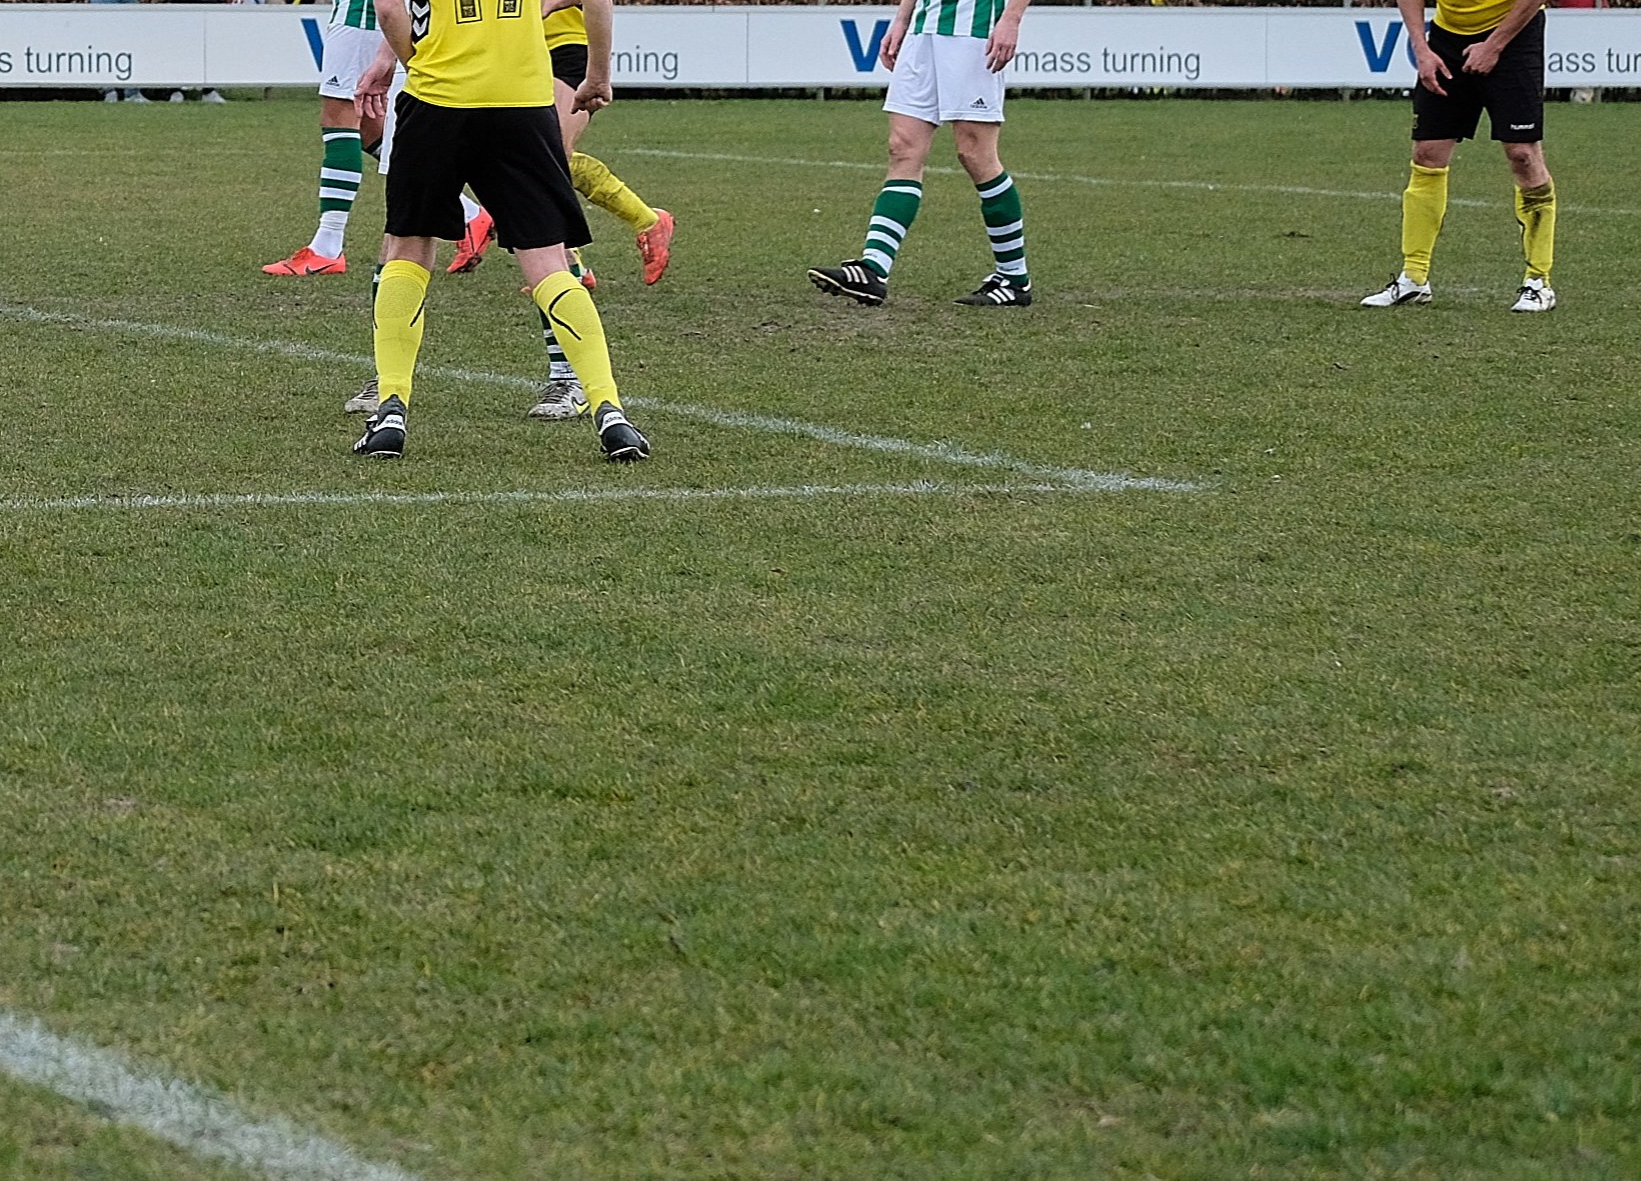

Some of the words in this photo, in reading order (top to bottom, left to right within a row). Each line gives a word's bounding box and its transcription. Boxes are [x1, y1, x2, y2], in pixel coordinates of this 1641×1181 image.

[25, 46, 132, 81] turning
[1015, 50, 1091, 73] mass
[1103, 46, 1200, 80] turning
[1548, 51, 1596, 73] ass
